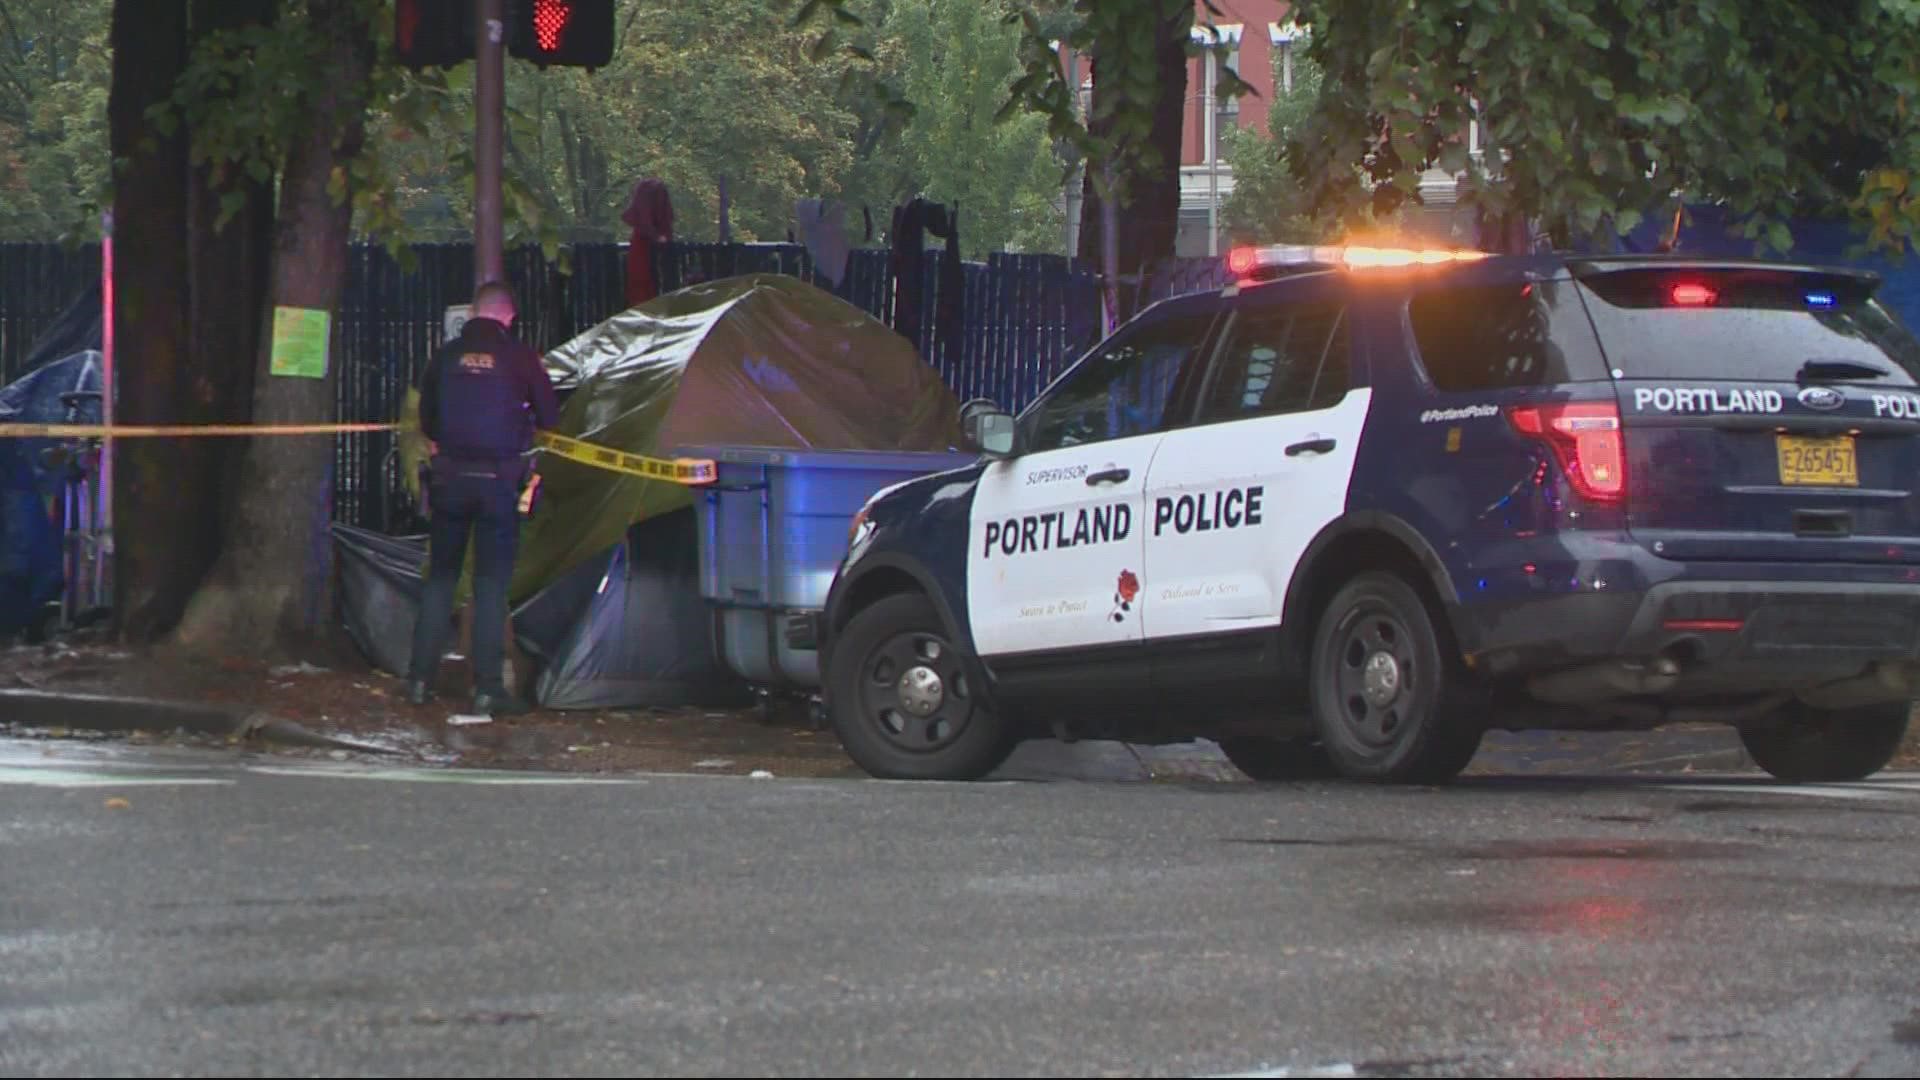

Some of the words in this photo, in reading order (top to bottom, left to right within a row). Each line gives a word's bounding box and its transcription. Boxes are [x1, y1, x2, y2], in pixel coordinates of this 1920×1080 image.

[1420, 404, 1499, 423] @PortlandPolice
[1635, 387, 1783, 414] PORTLAND
[1782, 446, 1853, 473] E265457
[1026, 464, 1088, 485] SUPERVISOR
[984, 502, 1131, 558] PORTLAND
[1154, 485, 1264, 537] POLICE
